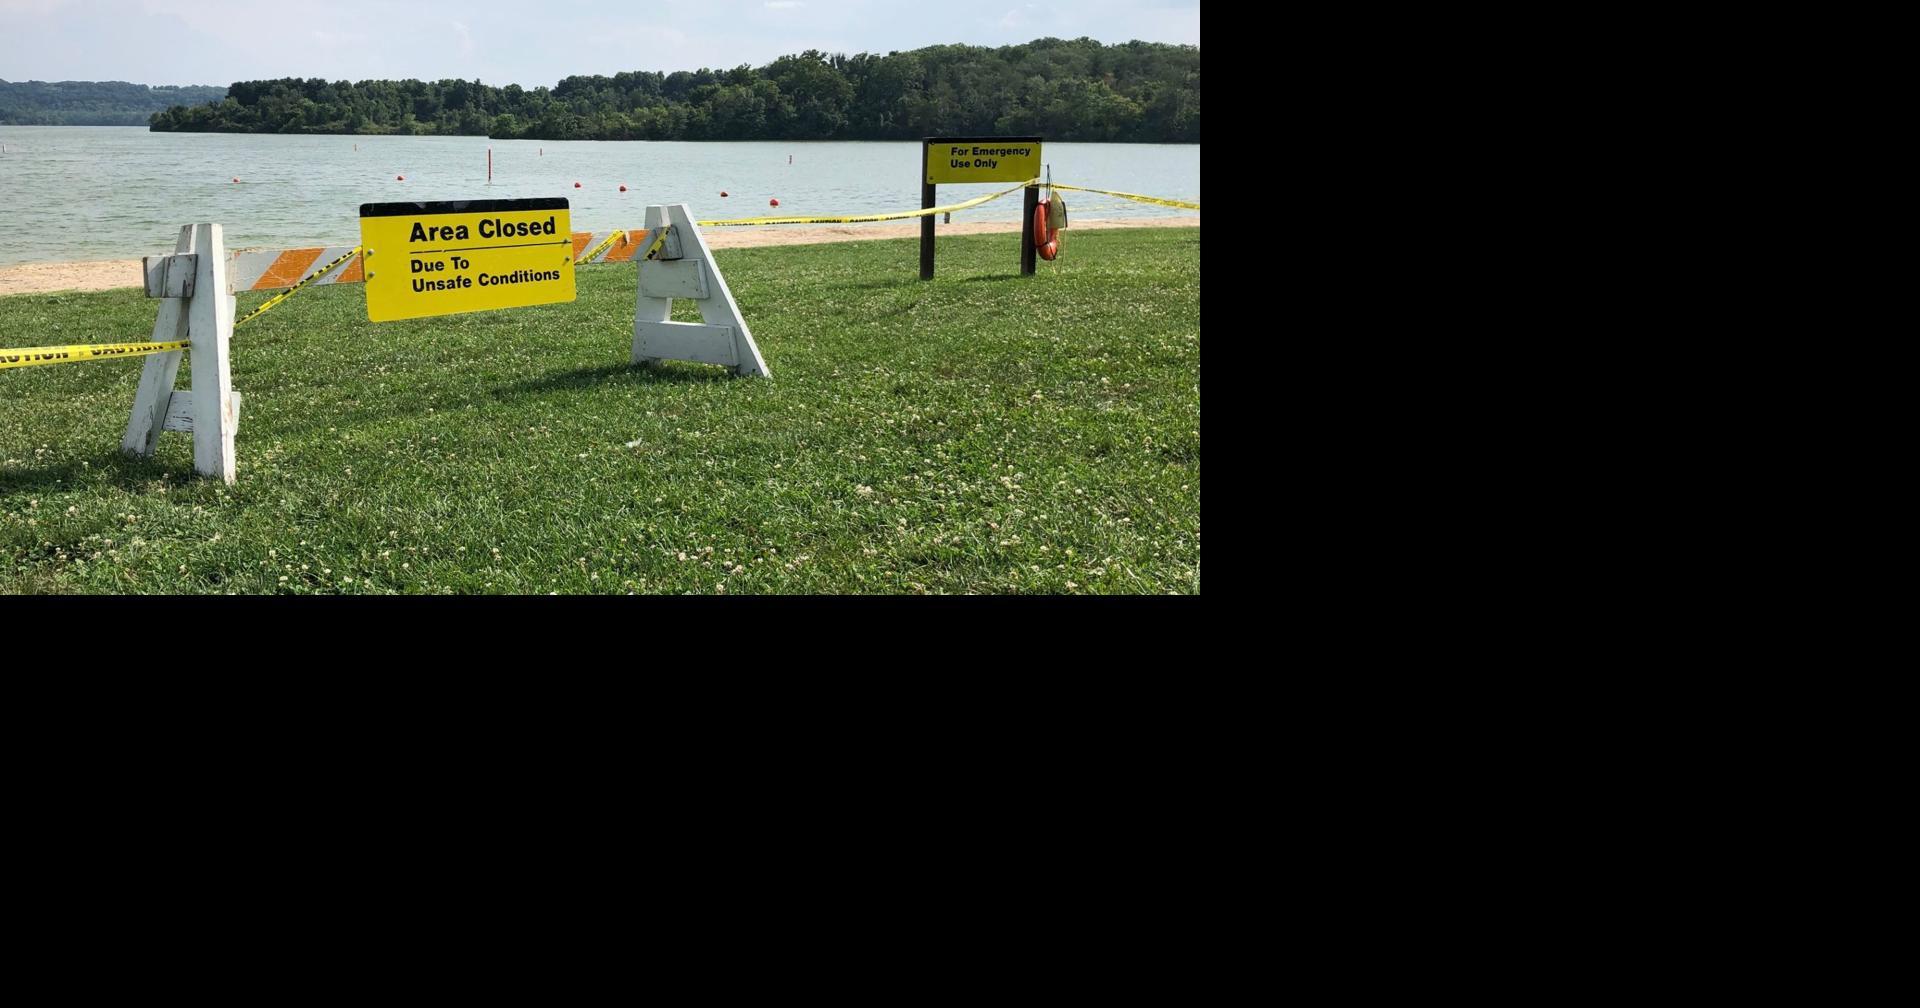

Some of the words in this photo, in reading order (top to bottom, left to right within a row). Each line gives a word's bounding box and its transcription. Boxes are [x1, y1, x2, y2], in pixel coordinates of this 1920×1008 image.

[950, 146, 969, 156] For
[972, 147, 1031, 157] Emergency
[950, 159, 971, 169] Use
[973, 158, 998, 169] Only
[409, 222, 470, 243] Area
[478, 216, 556, 239] Closed
[410, 259, 445, 274] Due
[450, 256, 470, 270] To
[412, 276, 472, 293] Unsafe
[478, 268, 561, 287] Conditions
